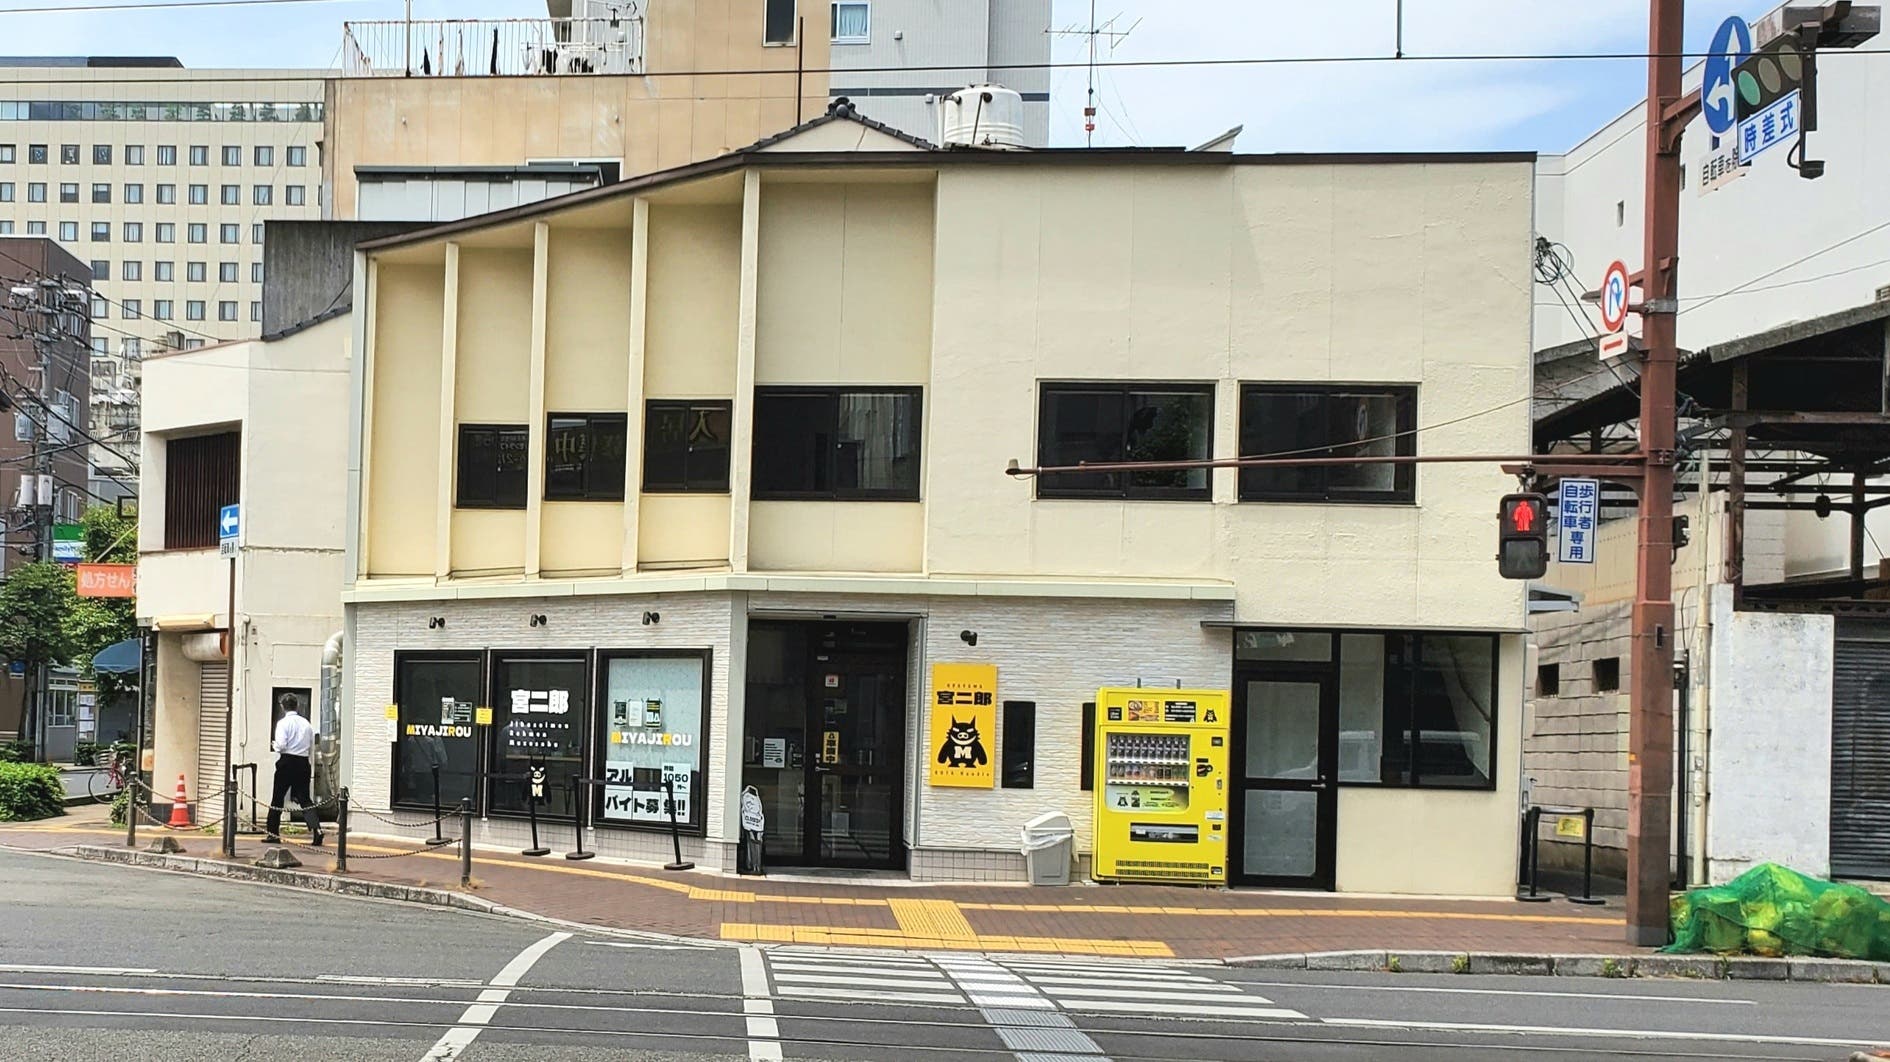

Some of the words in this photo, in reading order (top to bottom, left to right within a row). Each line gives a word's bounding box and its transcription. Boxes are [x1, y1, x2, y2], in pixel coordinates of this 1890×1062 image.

[1744, 100, 1794, 153] 時差式
[1563, 484, 1578, 529] 自転車
[1579, 485, 1594, 529] 歩行者
[1569, 531, 1585, 560] 専用
[81, 571, 131, 590] 処方せん
[511, 690, 569, 714] 宮二郎
[936, 690, 992, 706] 宮二郎
[406, 724, 472, 738] MIYAJIROU
[611, 731, 692, 746] MIYAJIROU
[607, 768, 632, 783] アル
[664, 773, 689, 782] 1050
